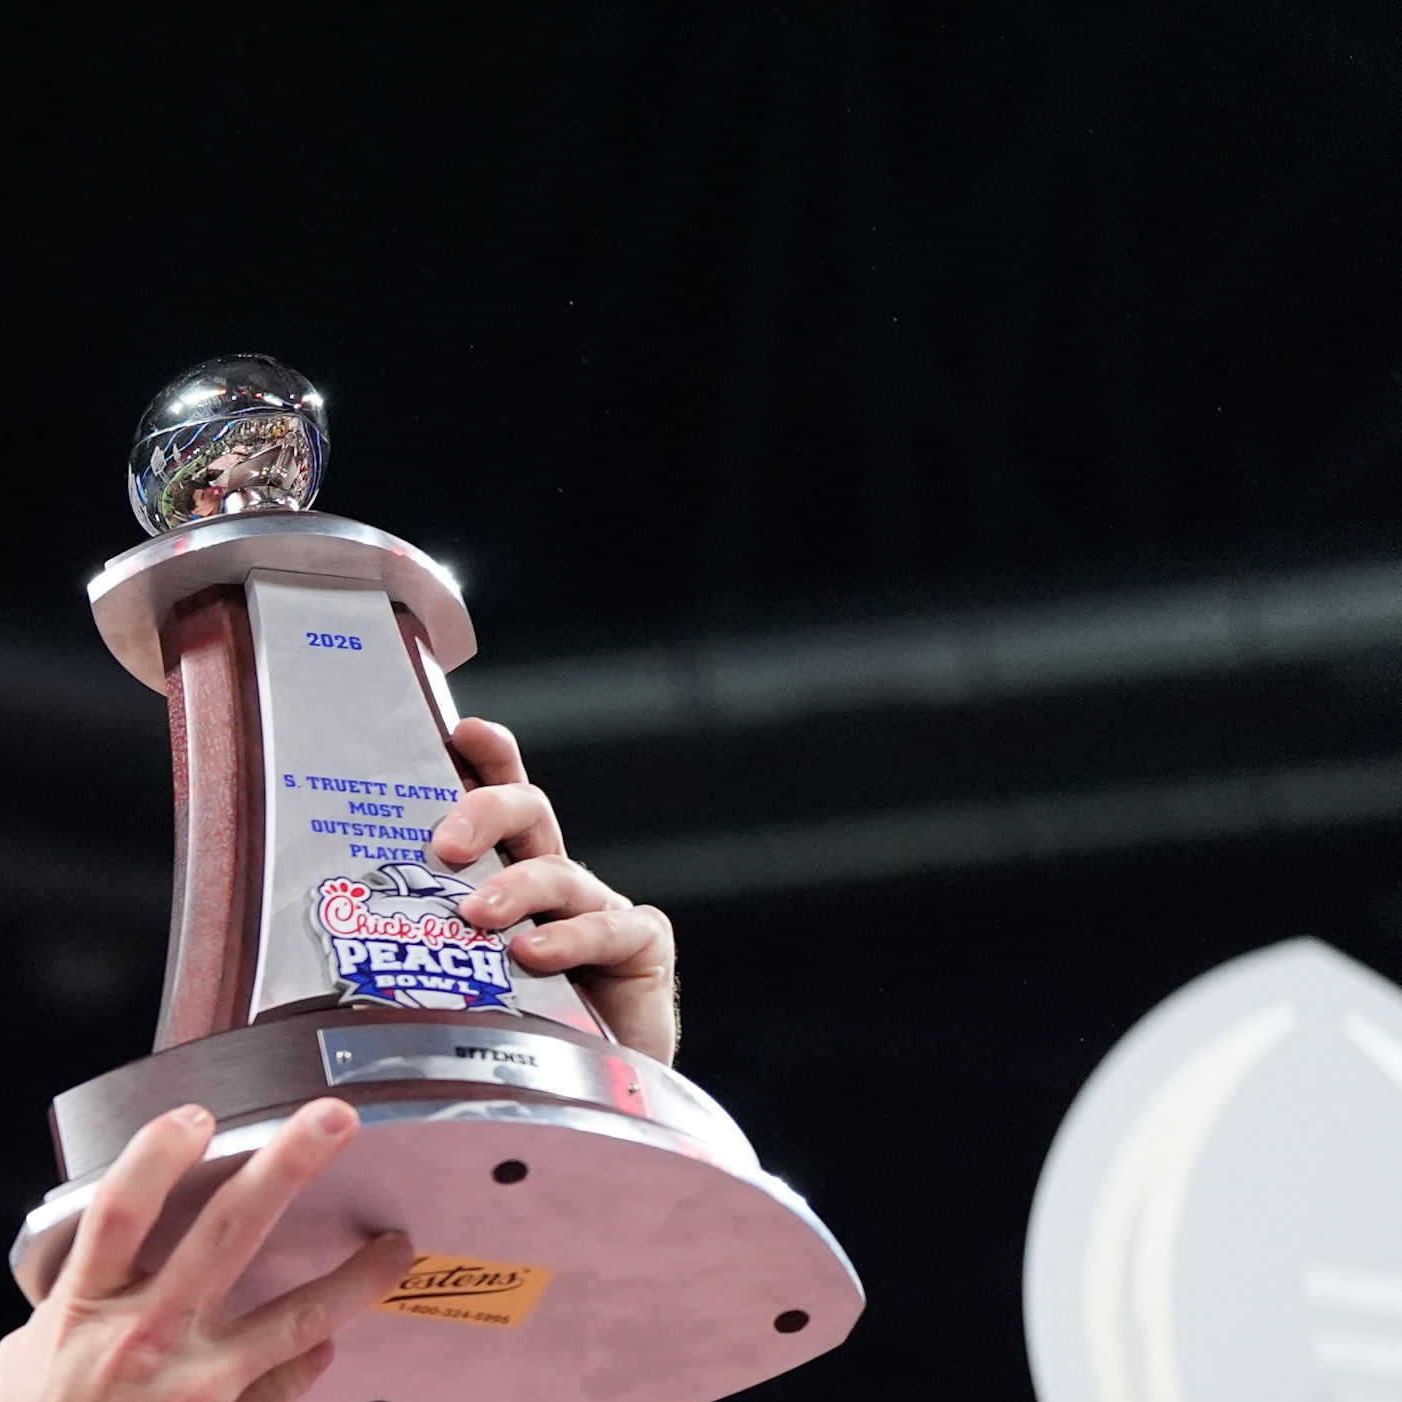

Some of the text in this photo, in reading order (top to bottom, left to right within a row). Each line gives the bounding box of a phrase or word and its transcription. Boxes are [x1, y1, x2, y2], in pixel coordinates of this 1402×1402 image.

[306, 632, 363, 651] 2026
[284, 774, 458, 802] S. TRUETT CATHY
[349, 802, 404, 818] MOST
[311, 819, 432, 843] OUTSTANDI
[349, 844, 428, 863] PLAYER
[324, 890, 501, 947] Chick-fil-A
[333, 938, 510, 989] PEACH
[375, 974, 480, 996] BOWL
[455, 1046, 538, 1067] OFFENSE
[391, 1256, 524, 1302] ostens
